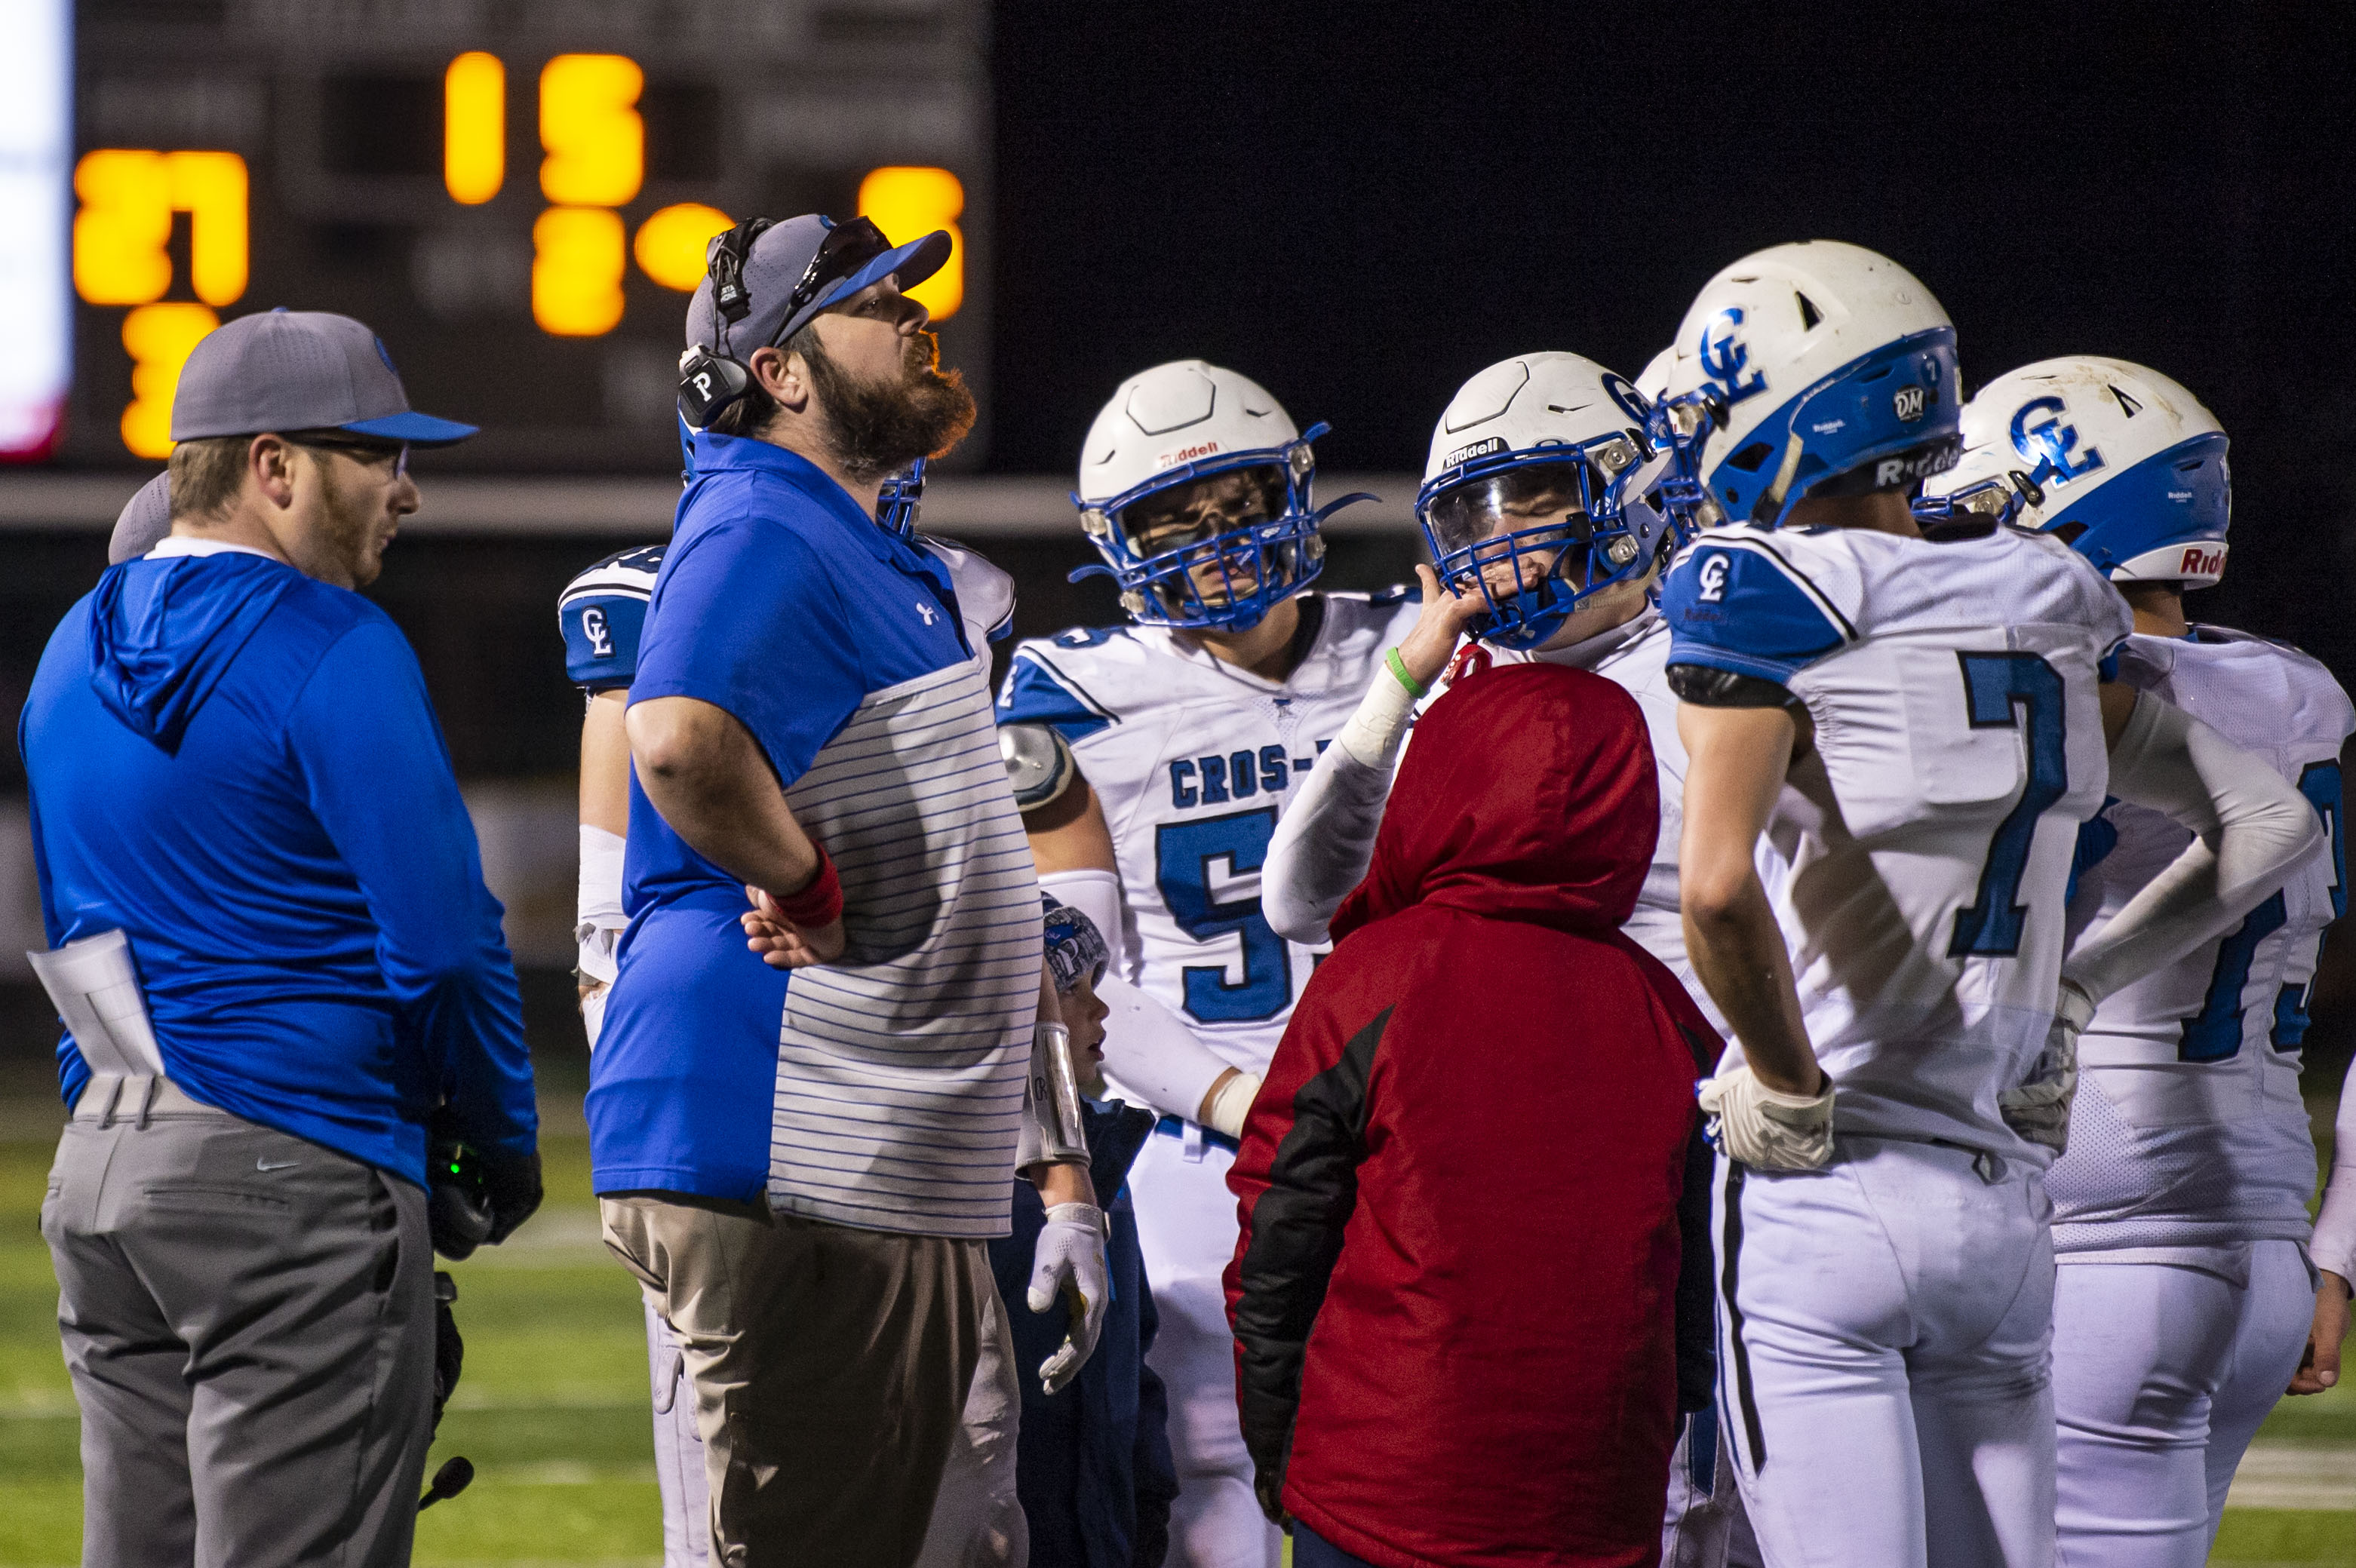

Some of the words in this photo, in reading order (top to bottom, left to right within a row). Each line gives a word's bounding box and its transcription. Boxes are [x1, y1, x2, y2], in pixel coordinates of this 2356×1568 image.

[693, 372, 712, 402] P
[1446, 437, 1498, 468] Riddell
[582, 608, 612, 655] CL
[1170, 739, 1332, 809] CROS-
[1947, 651, 2068, 958] 7
[1156, 805, 1292, 1023] 5
